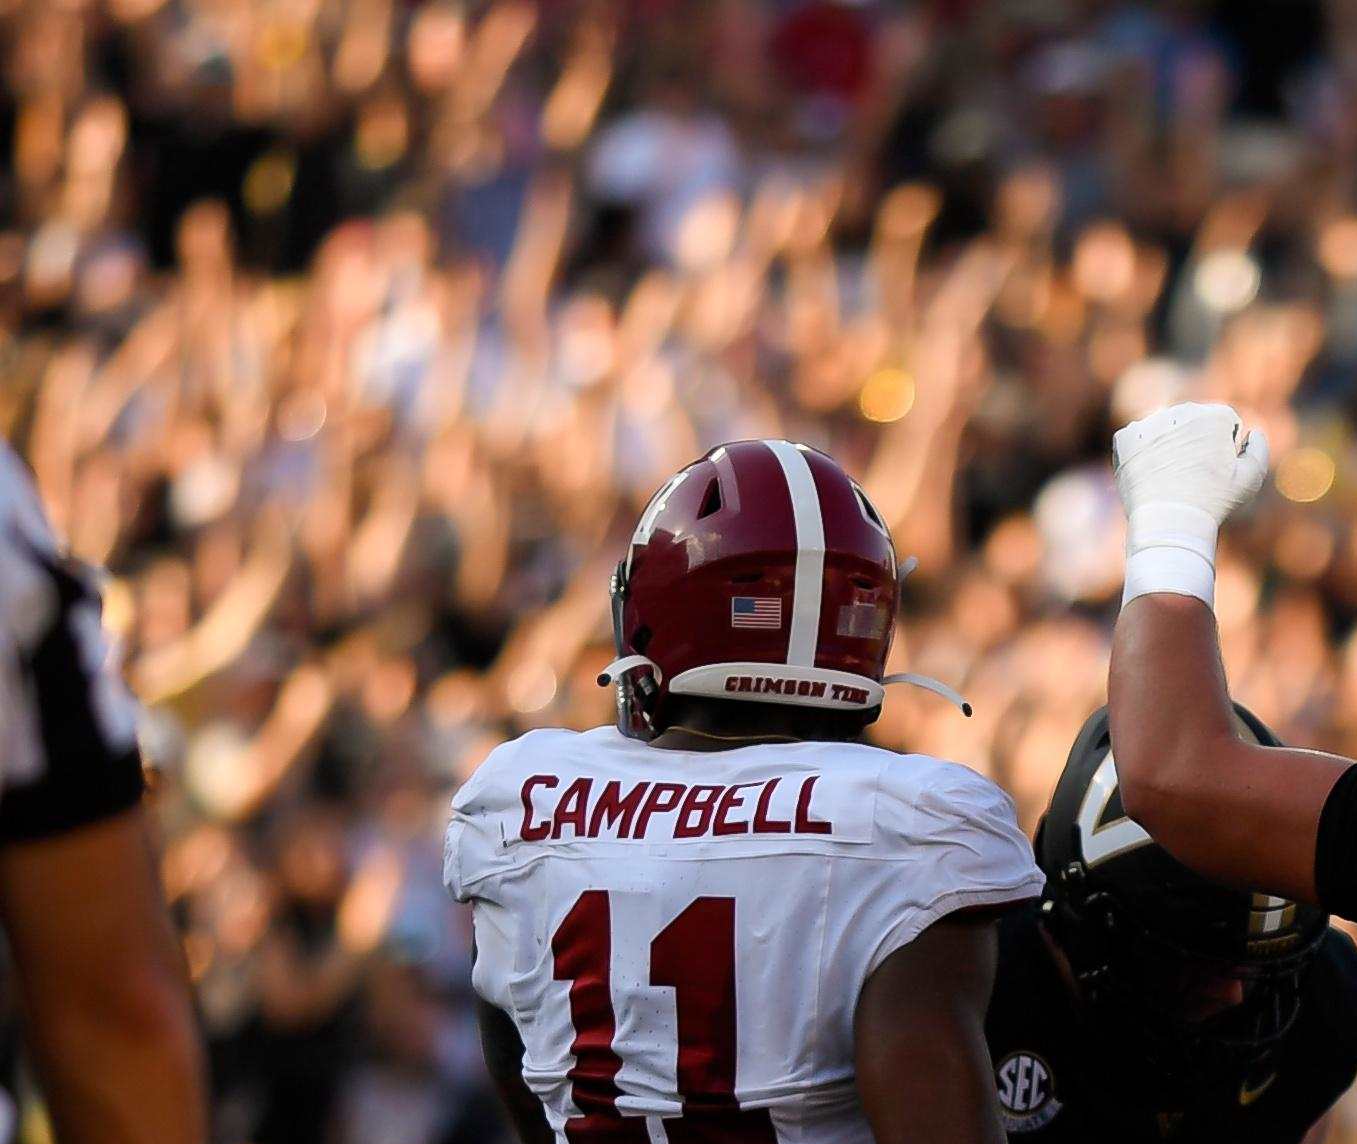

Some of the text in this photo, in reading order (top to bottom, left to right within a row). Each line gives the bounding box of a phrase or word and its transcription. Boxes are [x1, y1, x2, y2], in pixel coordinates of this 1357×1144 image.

[724, 675, 828, 699] CRIMSON
[519, 774, 833, 843] CAMPBELL
[998, 1055, 1048, 1111] SEC
